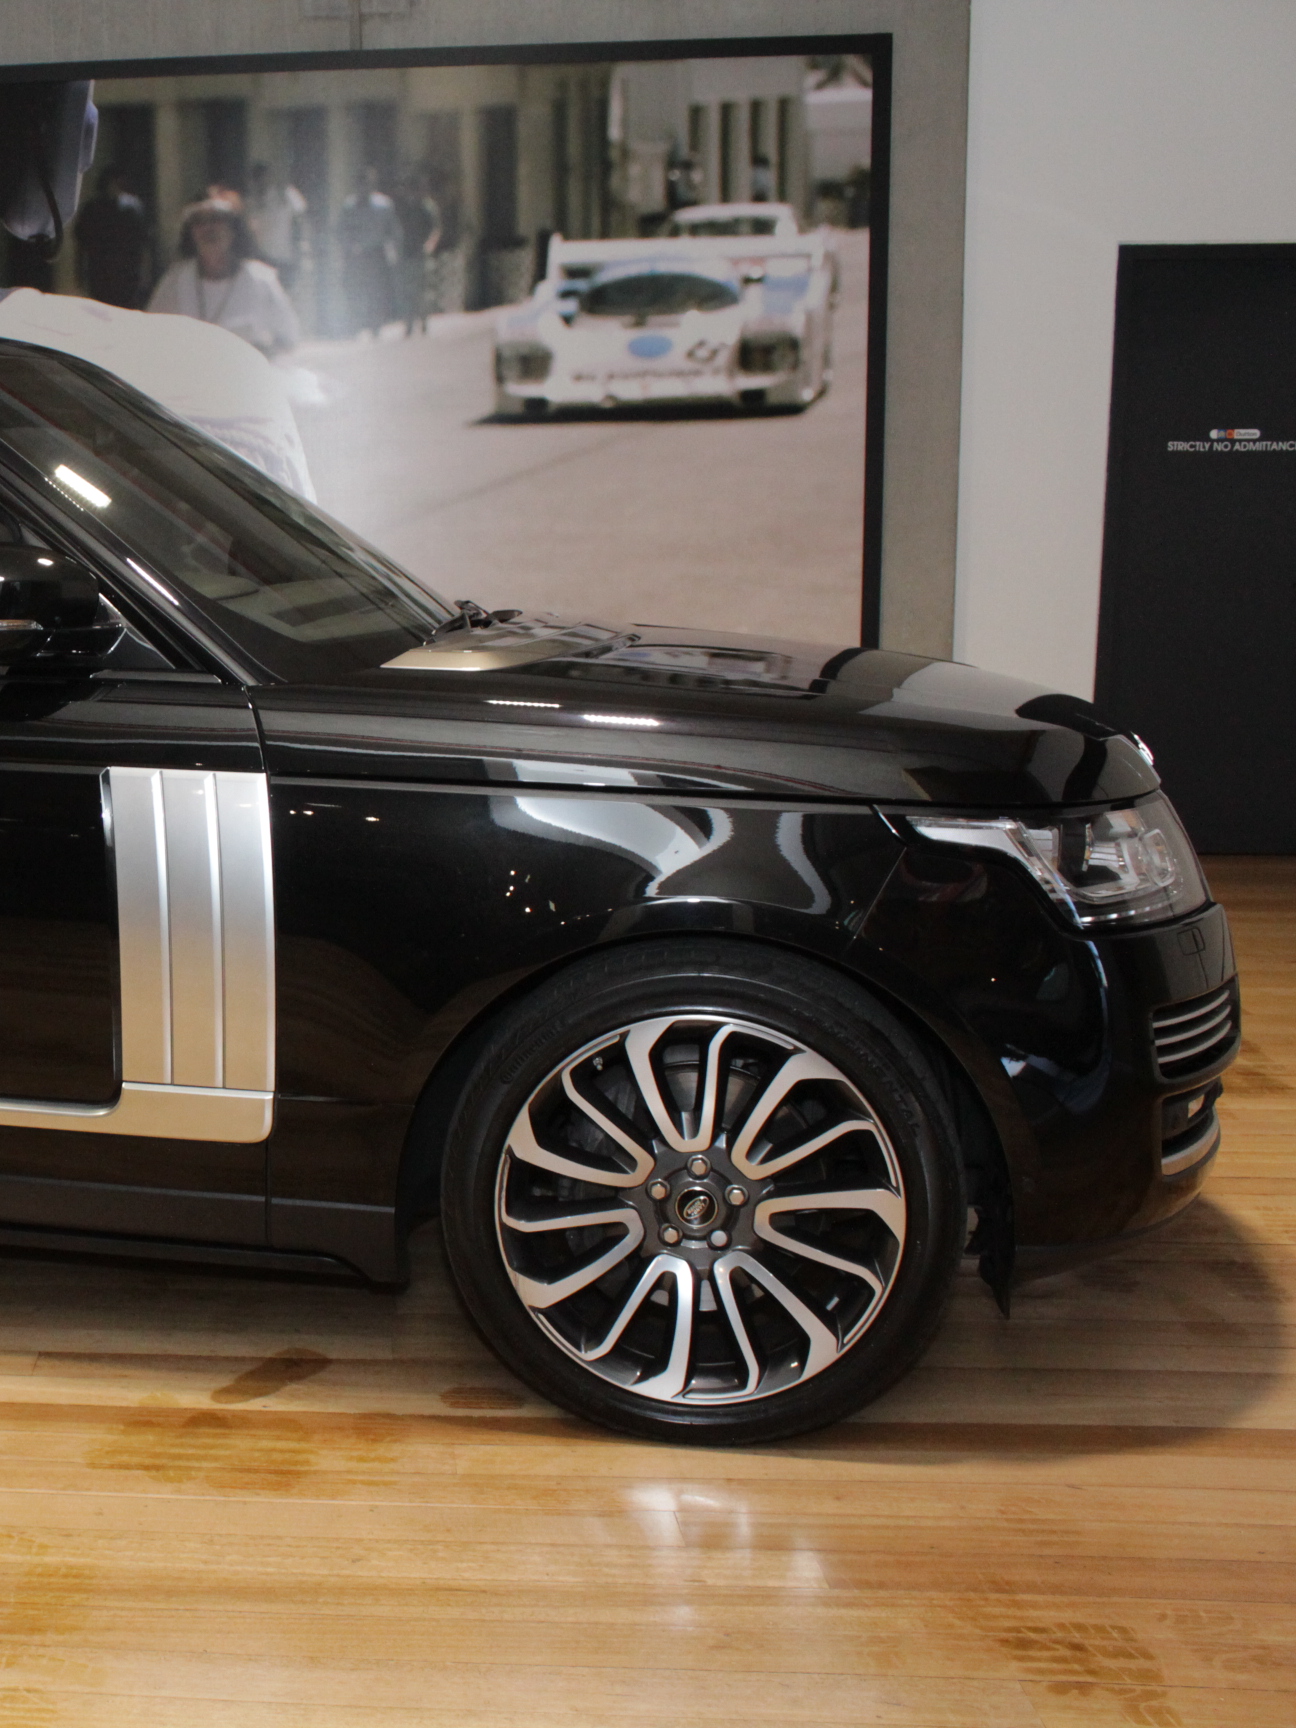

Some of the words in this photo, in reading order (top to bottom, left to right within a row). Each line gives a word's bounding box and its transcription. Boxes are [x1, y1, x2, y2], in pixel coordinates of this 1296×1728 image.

[1167, 441, 1210, 451] STRICTLY
[1213, 441, 1231, 451] NO
[1233, 441, 1296, 451] ADMITTANC
